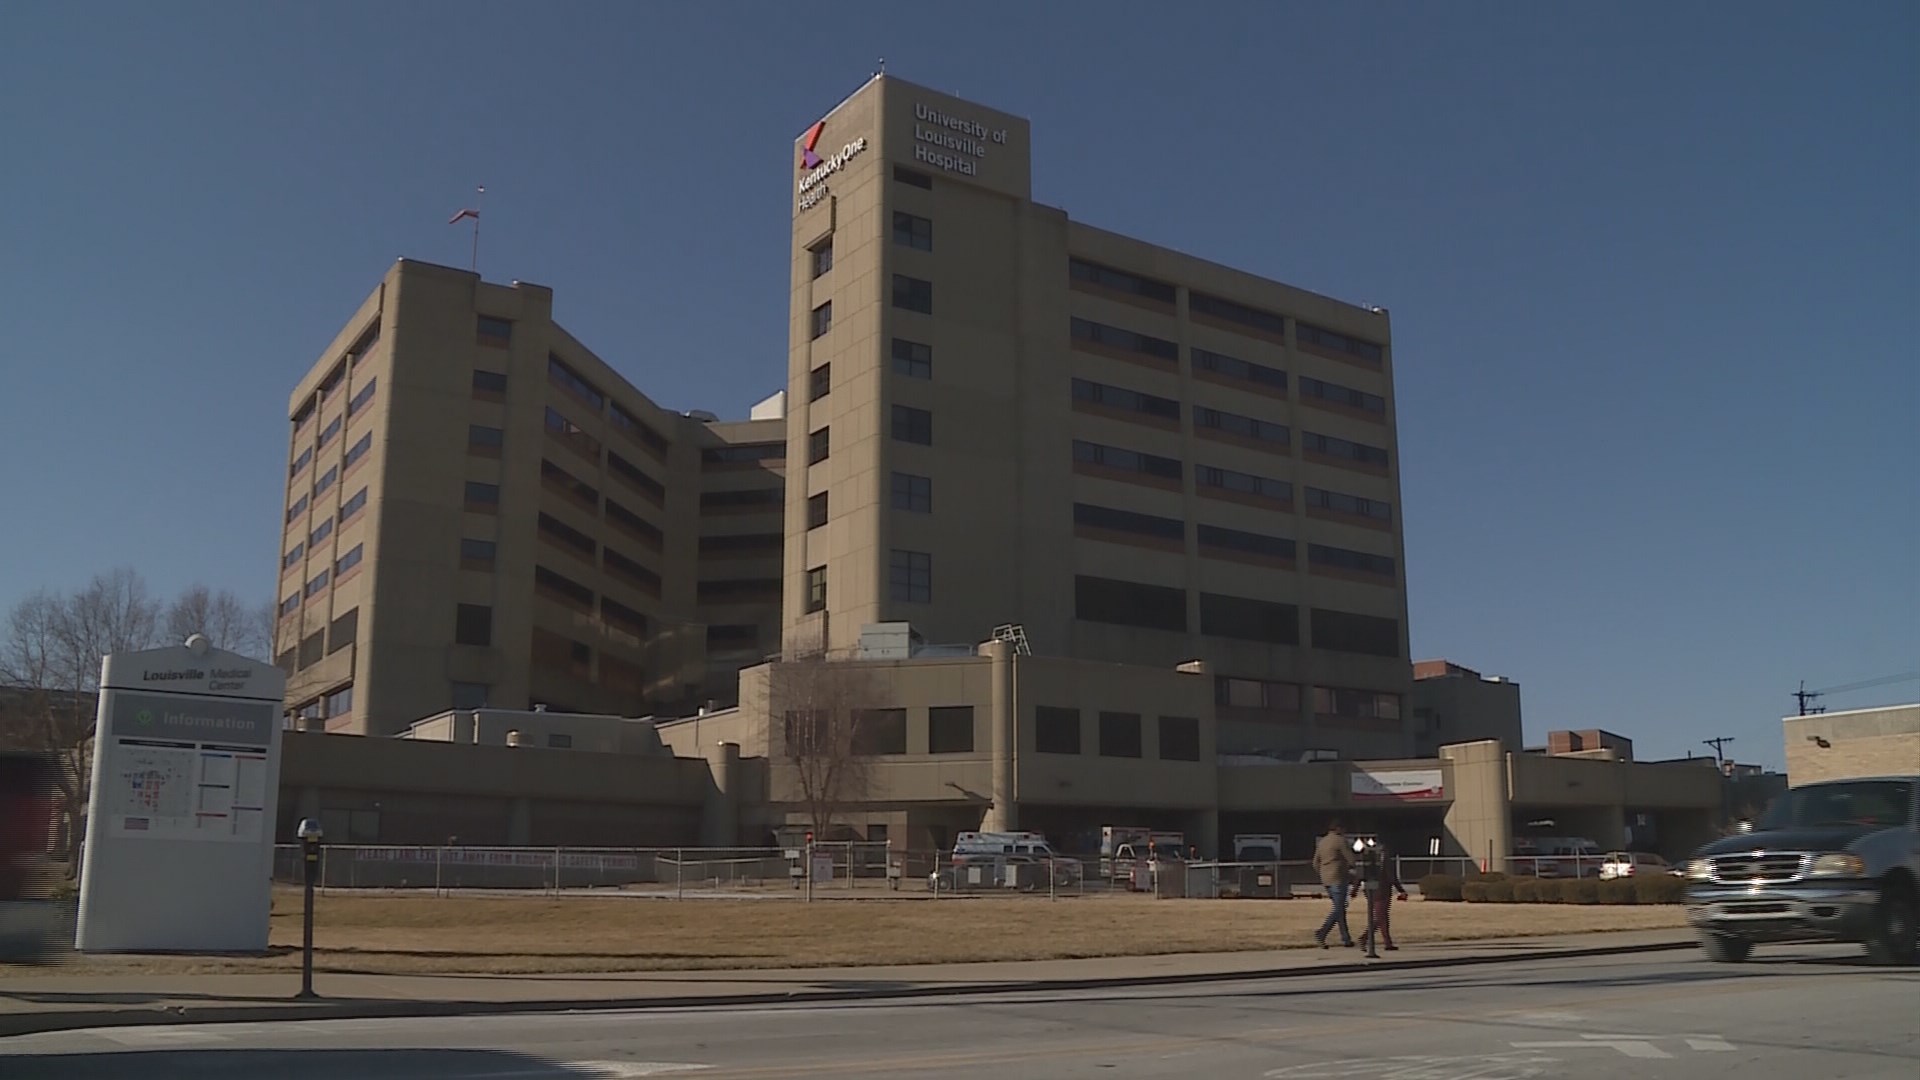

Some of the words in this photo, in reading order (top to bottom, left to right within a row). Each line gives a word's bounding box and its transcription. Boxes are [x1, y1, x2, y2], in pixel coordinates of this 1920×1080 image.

[915, 102, 988, 140] University
[992, 129, 1008, 144] of
[915, 123, 985, 157] Louisville
[798, 137, 865, 194] KentuckyOne
[915, 144, 976, 176] Hospital
[798, 182, 828, 211] Health
[143, 668, 204, 681] Louisville
[210, 668, 252, 680] Medical
[209, 680, 245, 691] Center
[163, 711, 256, 730] Information
